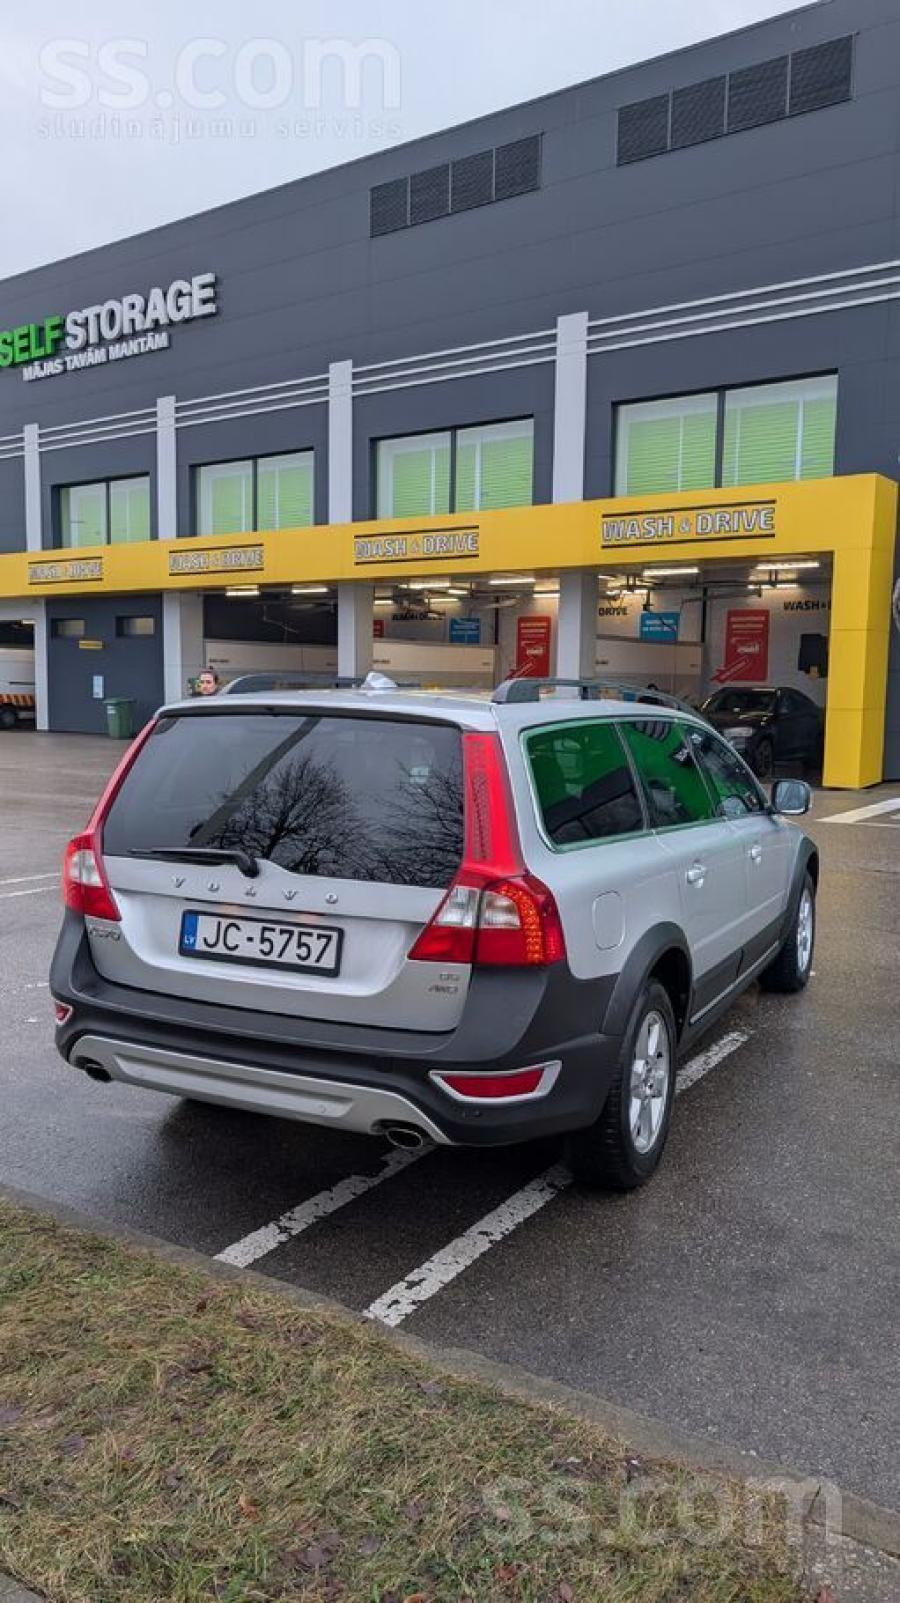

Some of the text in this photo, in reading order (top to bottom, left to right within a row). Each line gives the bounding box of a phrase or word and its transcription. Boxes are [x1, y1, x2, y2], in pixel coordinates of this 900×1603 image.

[0, 272, 216, 368] SELF STORAGE
[22, 331, 170, 381] MĀJAS TAVĀM MANTĀM
[602, 507, 776, 542] WASH & DRIVE
[354, 537, 407, 559] WASH
[423, 531, 479, 554] DRIVE
[598, 606, 628, 617] DRIVE
[783, 599, 820, 610] WASH
[172, 874, 339, 905] VOLVO
[203, 920, 332, 964] JC-5757
